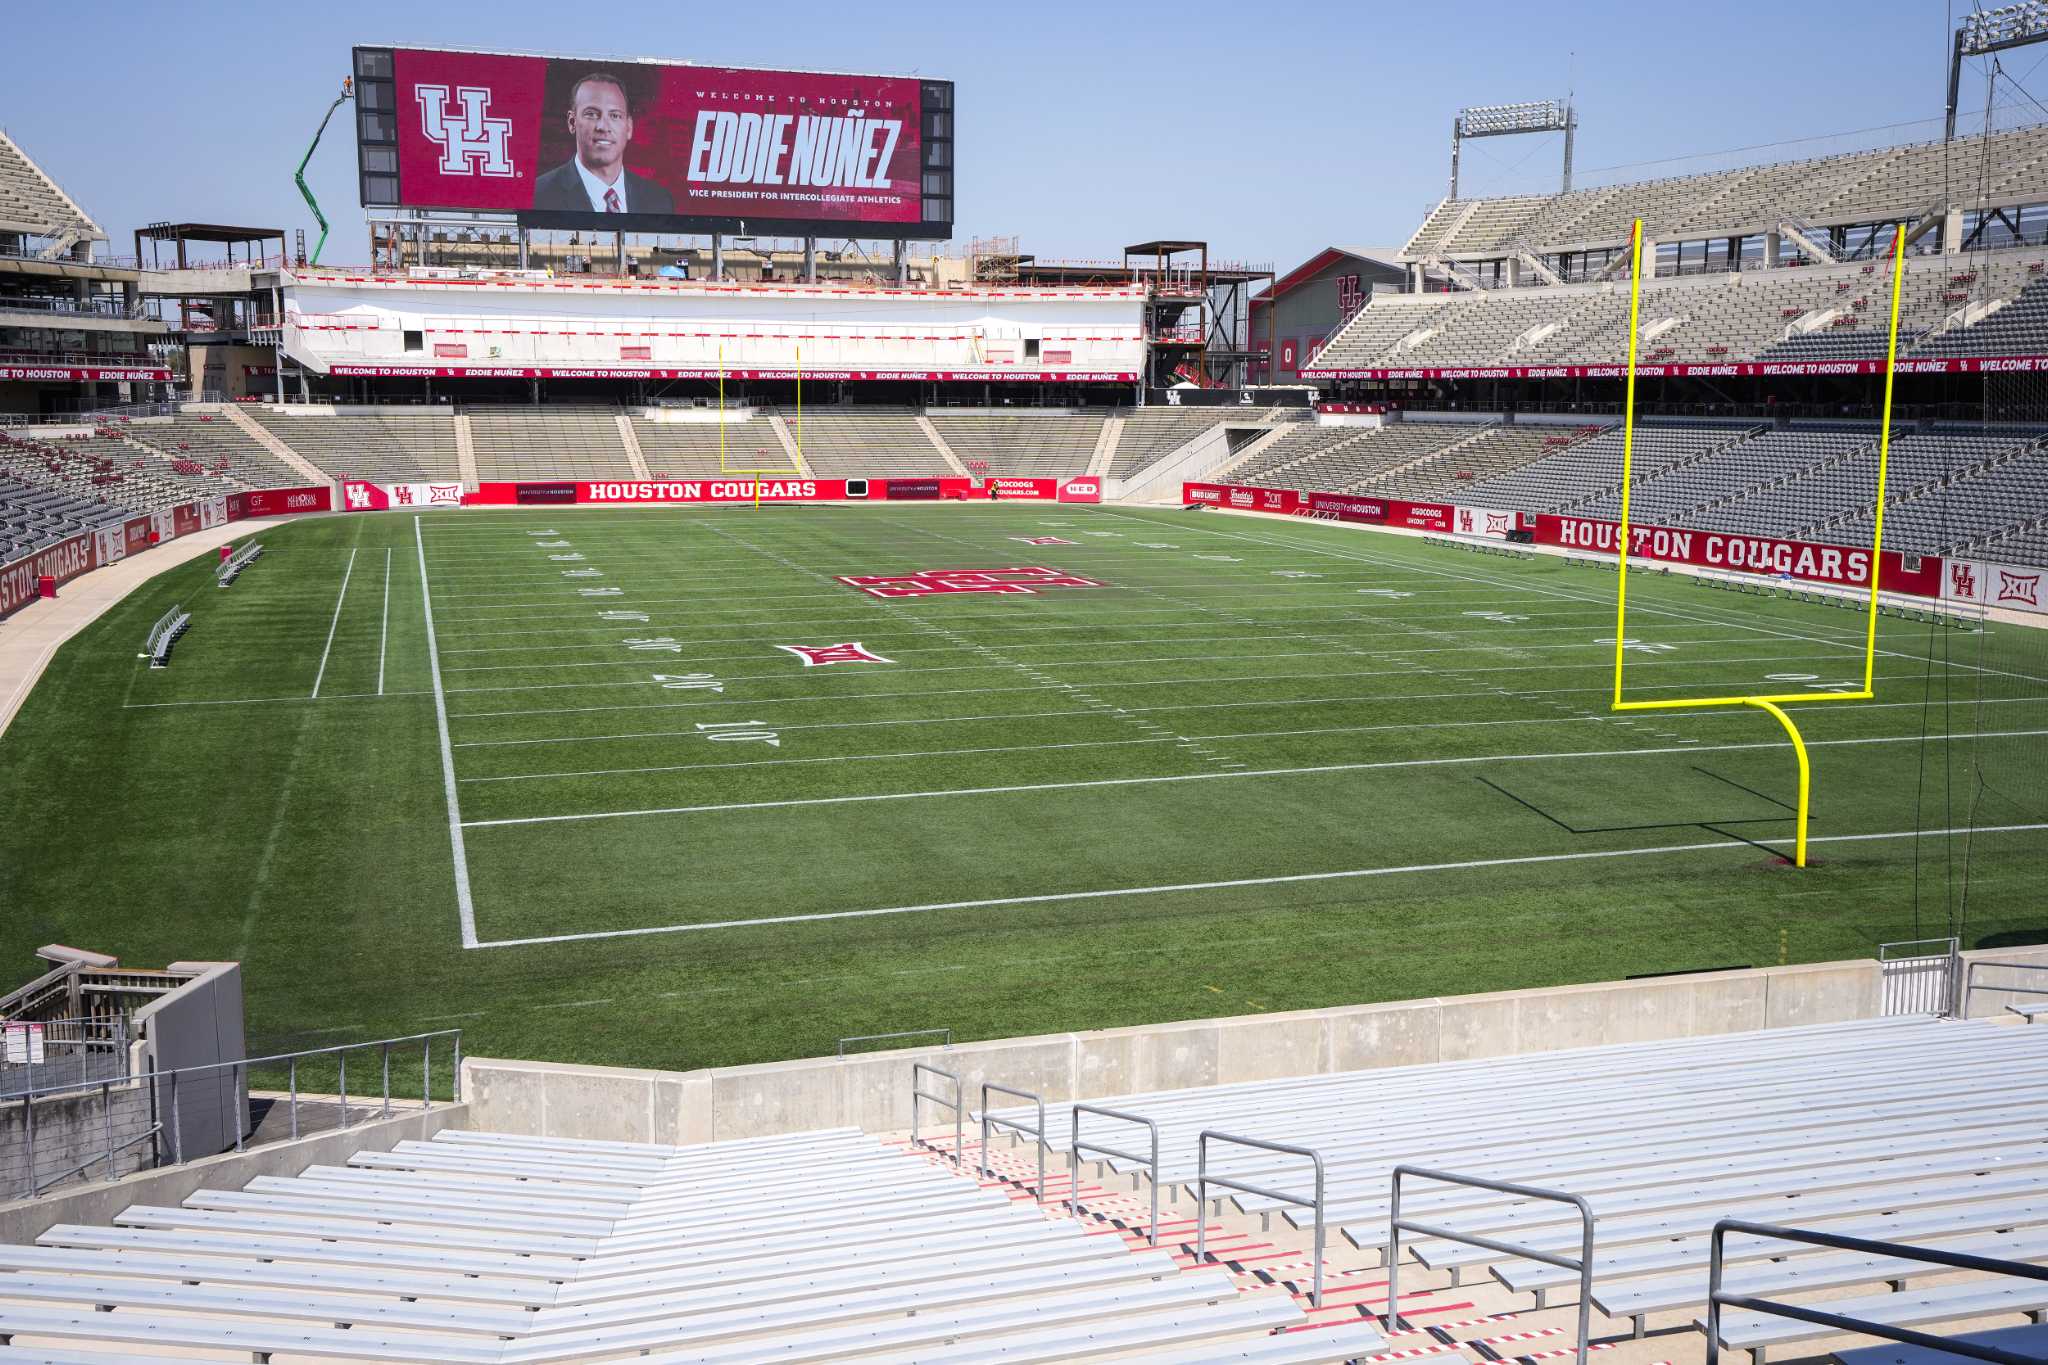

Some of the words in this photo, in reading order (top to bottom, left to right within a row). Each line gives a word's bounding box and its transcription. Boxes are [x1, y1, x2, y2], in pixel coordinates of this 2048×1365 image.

[696, 91, 775, 102] WELCOME
[819, 98, 893, 108] HOUSTON
[415, 83, 514, 177] UH
[687, 110, 793, 185] EDDIE
[788, 108, 903, 189] NUÑEZ
[689, 189, 709, 198] VICE
[711, 190, 759, 199] PRESIDENT
[761, 192, 778, 200] FOR
[780, 193, 855, 202] INTERCOLLEGIATE
[857, 196, 901, 204] ATHLETICS
[1587, 368, 1618, 376] WELCOME
[1619, 368, 1630, 376] TO
[1632, 367, 1664, 376] OUSTON
[1688, 366, 1710, 376] EDDIE
[1712, 364, 1738, 376] NUÑEZ
[1763, 364, 1805, 374] WELCOME
[1807, 364, 1816, 374] TO
[1818, 363, 1858, 374] HOUSTON
[1893, 362, 1914, 372] DDIE
[1916, 360, 1948, 372] NUÑEZ
[1980, 360, 2030, 371] WELCOME
[2030, 360, 2048, 370] TO
[11, 369, 24, 378] TO
[26, 370, 70, 378] HOUSTON
[100, 372, 124, 380] EDDIE
[126, 370, 154, 380] NUÑEZ
[1528, 368, 1546, 377] EDDIE
[590, 484, 700, 499] HOUSTON
[710, 482, 816, 496] COUGARS
[1192, 490, 1204, 498] BUD
[1204, 492, 1219, 500] LIGHT
[1316, 501, 1346, 512] UNIVERSITY
[1352, 504, 1380, 514] HOUSTON
[1560, 520, 1692, 560] HOUSTON
[1706, 536, 1868, 582] COUGARS
[1952, 563, 1975, 597] UH
[0, 562, 34, 612] STON
